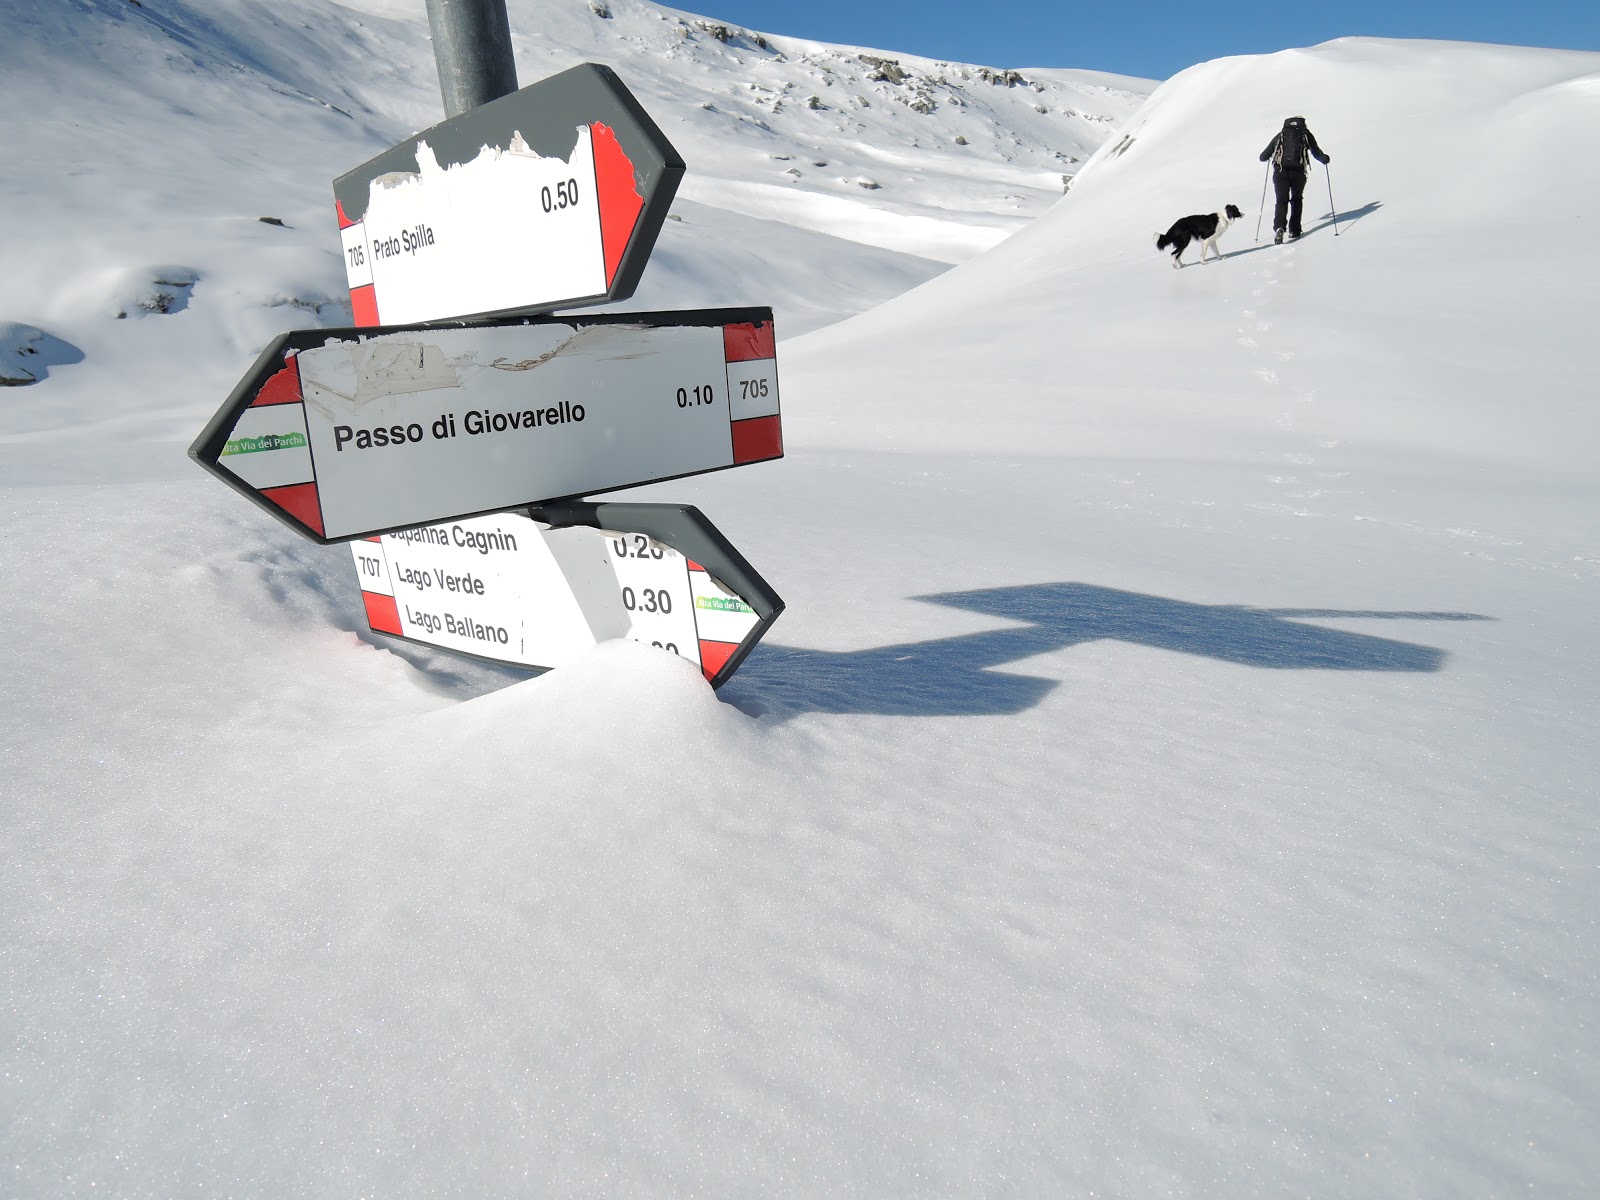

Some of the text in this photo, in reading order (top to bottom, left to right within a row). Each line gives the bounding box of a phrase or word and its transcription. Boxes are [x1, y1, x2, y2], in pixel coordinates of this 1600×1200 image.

[541, 177, 579, 213] 0.50
[347, 244, 365, 268] 705
[373, 223, 435, 261] Prato Spilla
[676, 384, 714, 408] 0.10
[739, 378, 769, 400] 705
[333, 400, 586, 452] Passo di Giovarello
[223, 435, 303, 453] lta Via dei Parchi
[389, 525, 518, 555] apanna Cagnin
[358, 555, 381, 578] 707
[395, 561, 486, 596] Lago Verde
[622, 586, 672, 614] 0.30
[711, 600, 724, 608] Via
[724, 601, 735, 610] dei
[405, 604, 509, 645] Lago Ballano
